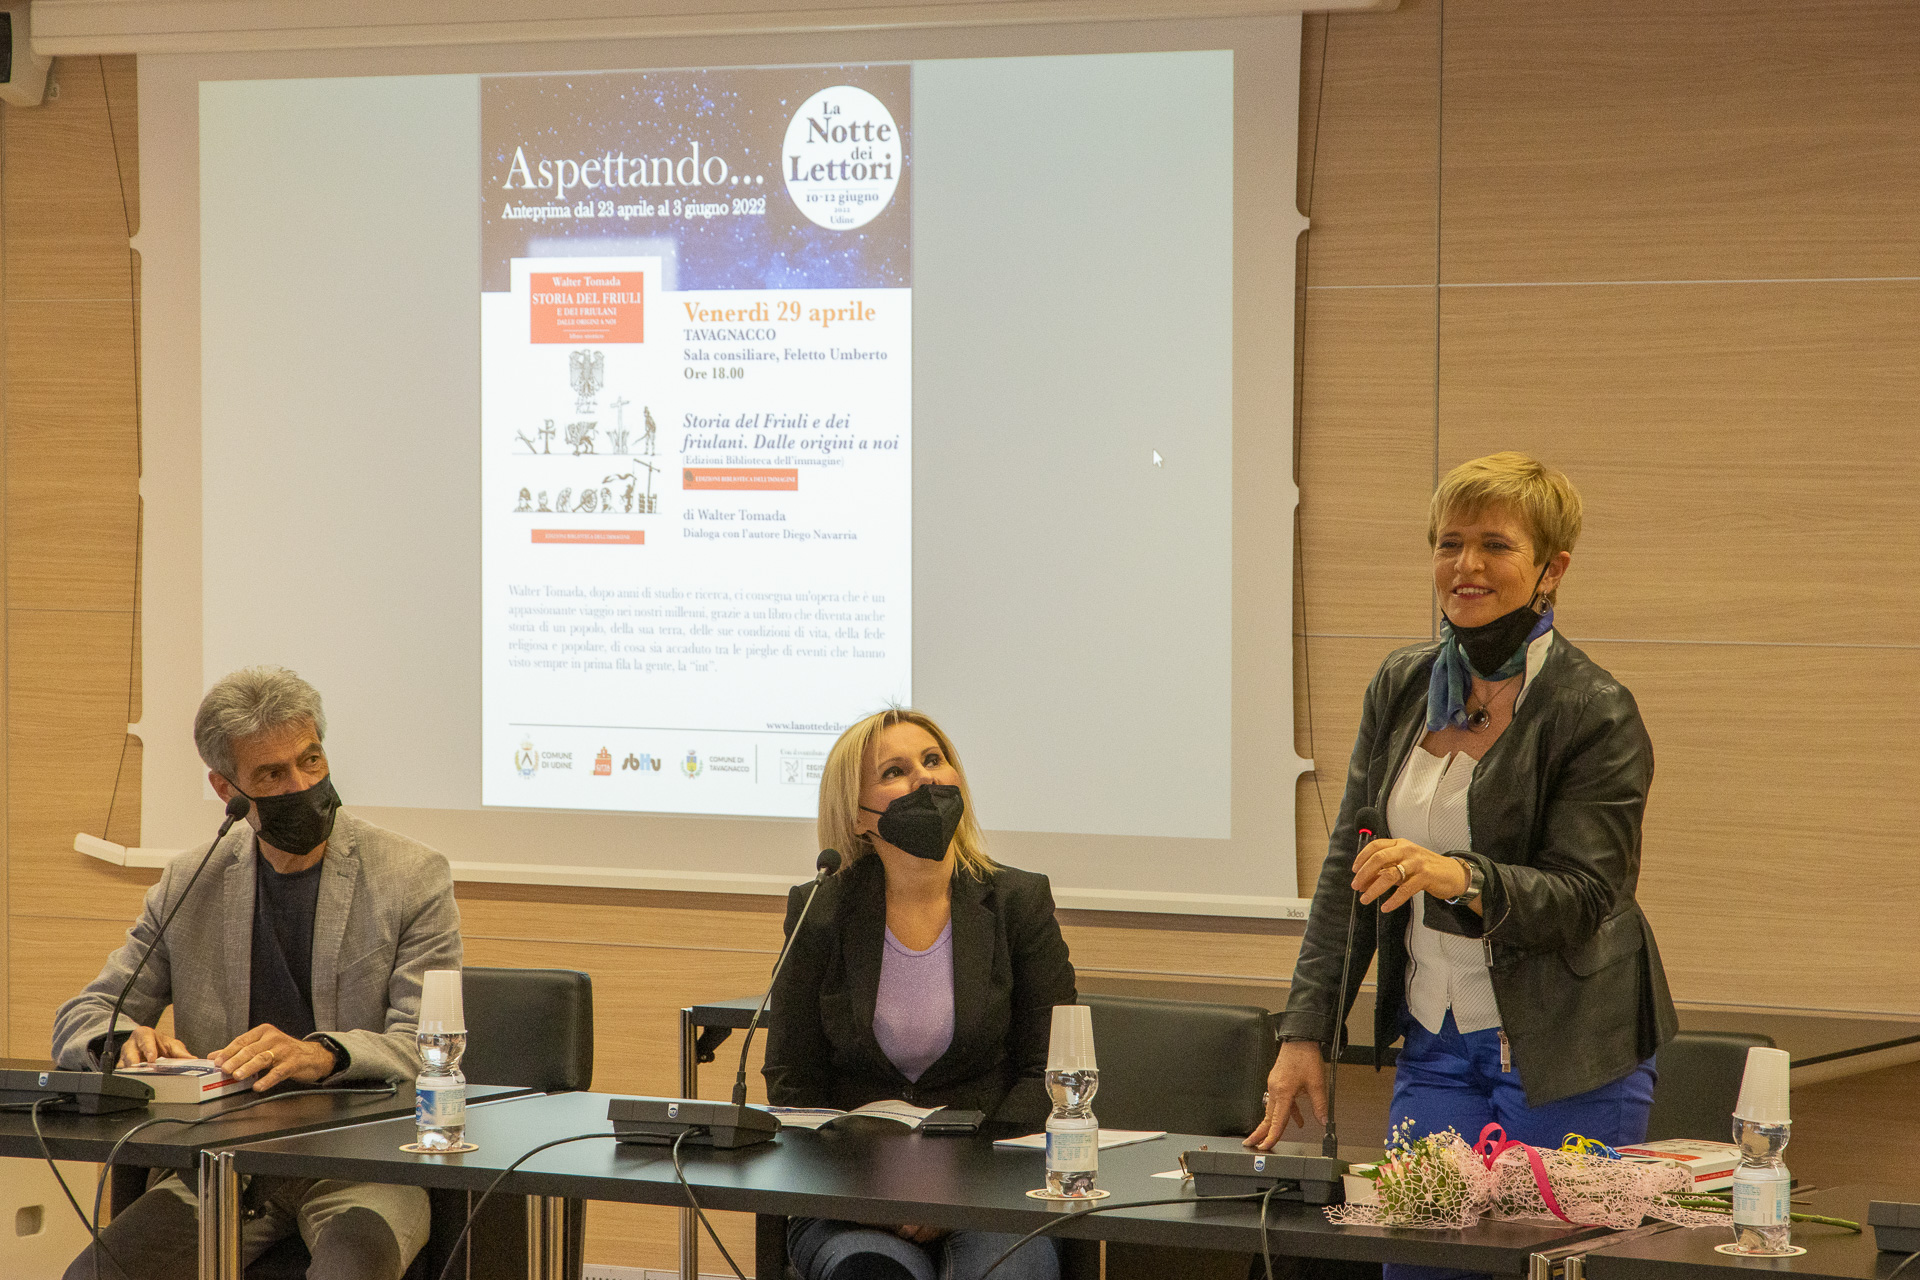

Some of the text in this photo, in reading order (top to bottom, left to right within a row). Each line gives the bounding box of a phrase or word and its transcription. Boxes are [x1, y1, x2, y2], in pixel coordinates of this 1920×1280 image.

[823, 102, 840, 114] La
[807, 117, 891, 143] Notte
[851, 147, 872, 160] dei
[503, 142, 764, 199] Aspettando...
[789, 154, 893, 182] Lettori
[807, 191, 879, 206] 10-12 giugno
[502, 198, 765, 222] Anteprima dal 23 aprile al 3 giugno 2022
[830, 215, 854, 225] Udine
[552, 276, 621, 287] Walter Tomada
[532, 292, 641, 305] STORIA DEL FRIULI
[557, 307, 617, 316] E DEI FRIULANI
[684, 301, 875, 328] Venerdì 29 aprile
[684, 329, 776, 341] TAVAGNACCO
[684, 349, 887, 362] Sala consiliare, Feletto Umberto
[684, 367, 744, 380] Ore 18.00
[683, 413, 850, 428] Storia del Friuli e dei
[680, 434, 899, 454] friulani. Dalle origini a noi
[682, 455, 723, 465] (Edizioni
[726, 456, 772, 465] Biblioteca
[683, 509, 786, 521] di Walter Tomada
[683, 528, 857, 541] Dialoga con l'autore Diego Navarria
[509, 585, 540, 597] Walter
[543, 585, 587, 598] Tomada,
[590, 586, 615, 601] dopo
[617, 587, 639, 598] anni
[642, 587, 651, 598] di
[655, 588, 684, 599] studio
[695, 588, 731, 601] ricerca,
[735, 589, 743, 600] ci
[745, 593, 791, 603] consegna
[795, 590, 839, 605] un'opera
[842, 590, 860, 602] che
[863, 591, 868, 602] è
[872, 594, 885, 603] un
[508, 604, 576, 619] appassionante
[579, 604, 614, 619] viaggio
[617, 605, 632, 616] nei
[635, 606, 662, 617] nostri
[665, 606, 708, 619] millenni,
[711, 607, 740, 620] grazie
[768, 608, 791, 620] libro
[794, 609, 812, 620] che
[815, 609, 852, 621] diventa
[855, 610, 885, 622] anche
[509, 622, 535, 633] storia
[539, 621, 549, 632] di
[553, 625, 565, 633] un
[570, 622, 606, 636] popolo,
[610, 622, 634, 634] della
[659, 625, 685, 636] terra,
[690, 624, 712, 636] delle
[738, 625, 790, 638] condizioni
[794, 626, 804, 638] di
[809, 627, 830, 639] vita,
[835, 628, 859, 639] della
[864, 628, 885, 639] fede
[509, 639, 885, 659] religiosa e popolare, di cosa sia accaduto tra le pieghe di eventi che hanno
[509, 656, 531, 667] visto
[533, 659, 568, 671] sempre
[571, 657, 580, 669] in
[584, 658, 613, 672] prima
[616, 658, 631, 670] fila
[634, 659, 642, 670] la
[645, 661, 675, 674] gente,
[678, 660, 686, 671] la
